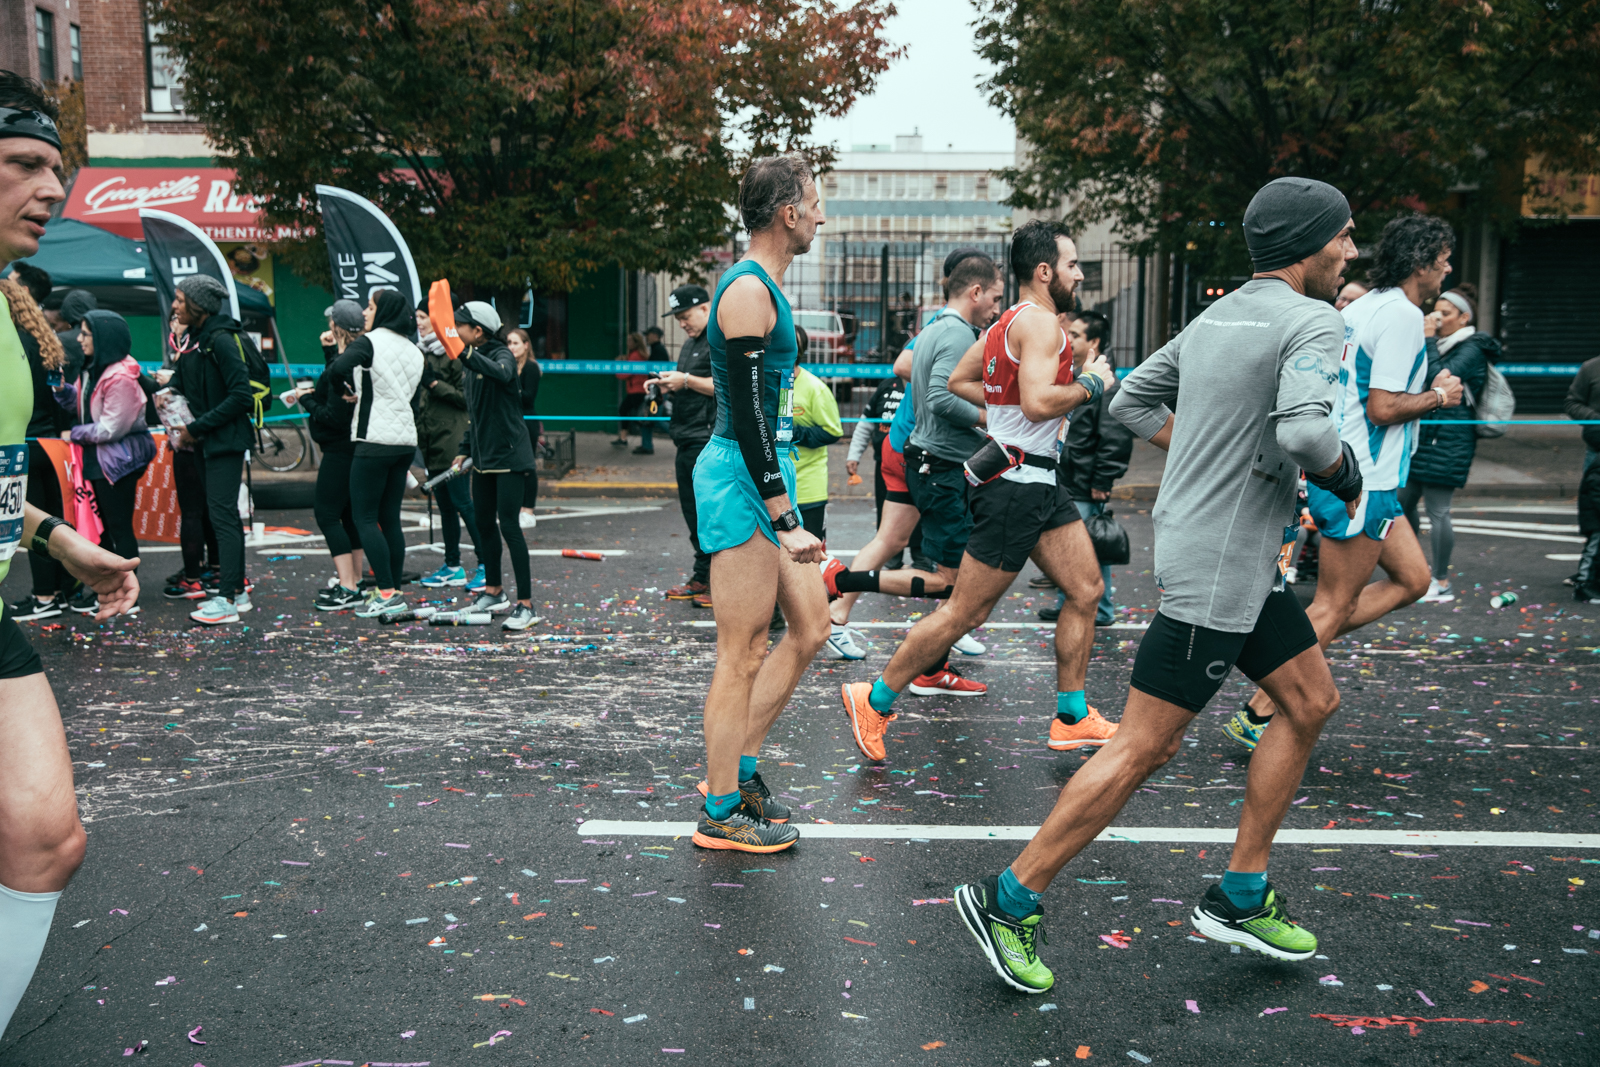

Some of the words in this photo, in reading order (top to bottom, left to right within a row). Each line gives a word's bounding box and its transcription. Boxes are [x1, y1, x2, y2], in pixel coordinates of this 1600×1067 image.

[752, 392, 760, 410] YORK
[754, 409, 765, 425] CITY
[758, 422, 774, 462] MARATHON
[0, 481, 23, 514] 450
